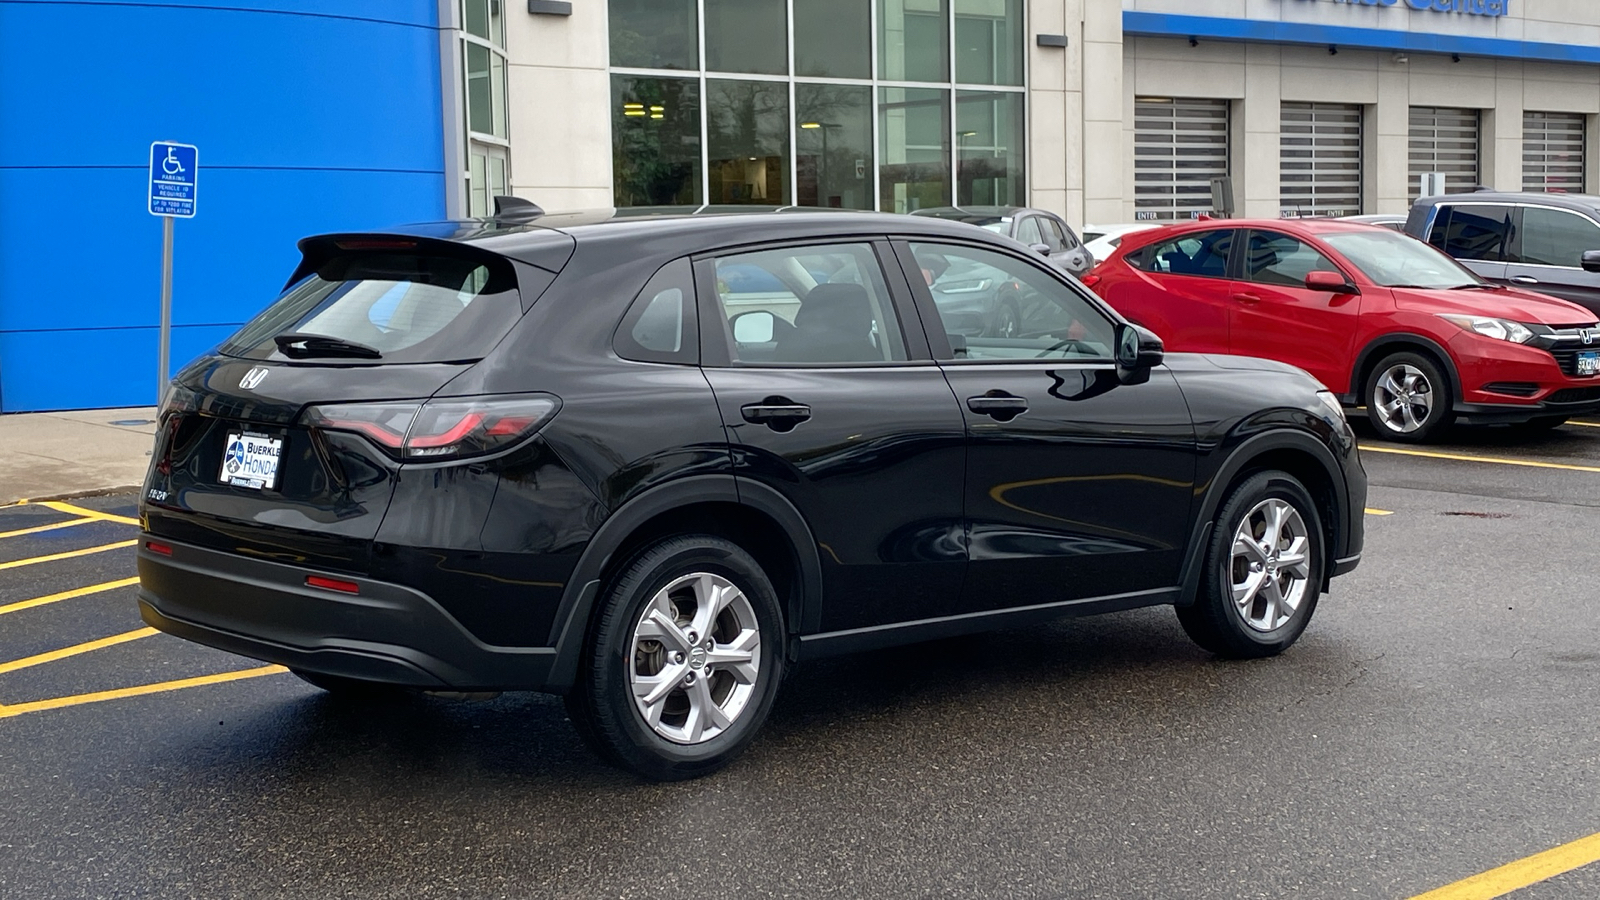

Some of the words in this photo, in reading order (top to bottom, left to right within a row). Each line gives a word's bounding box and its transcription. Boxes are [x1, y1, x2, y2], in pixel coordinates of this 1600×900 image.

[1137, 211, 1158, 220] ENTER
[1327, 209, 1344, 217] ENTER
[247, 442, 281, 456] BUERKLE
[243, 455, 277, 475] HONDA
